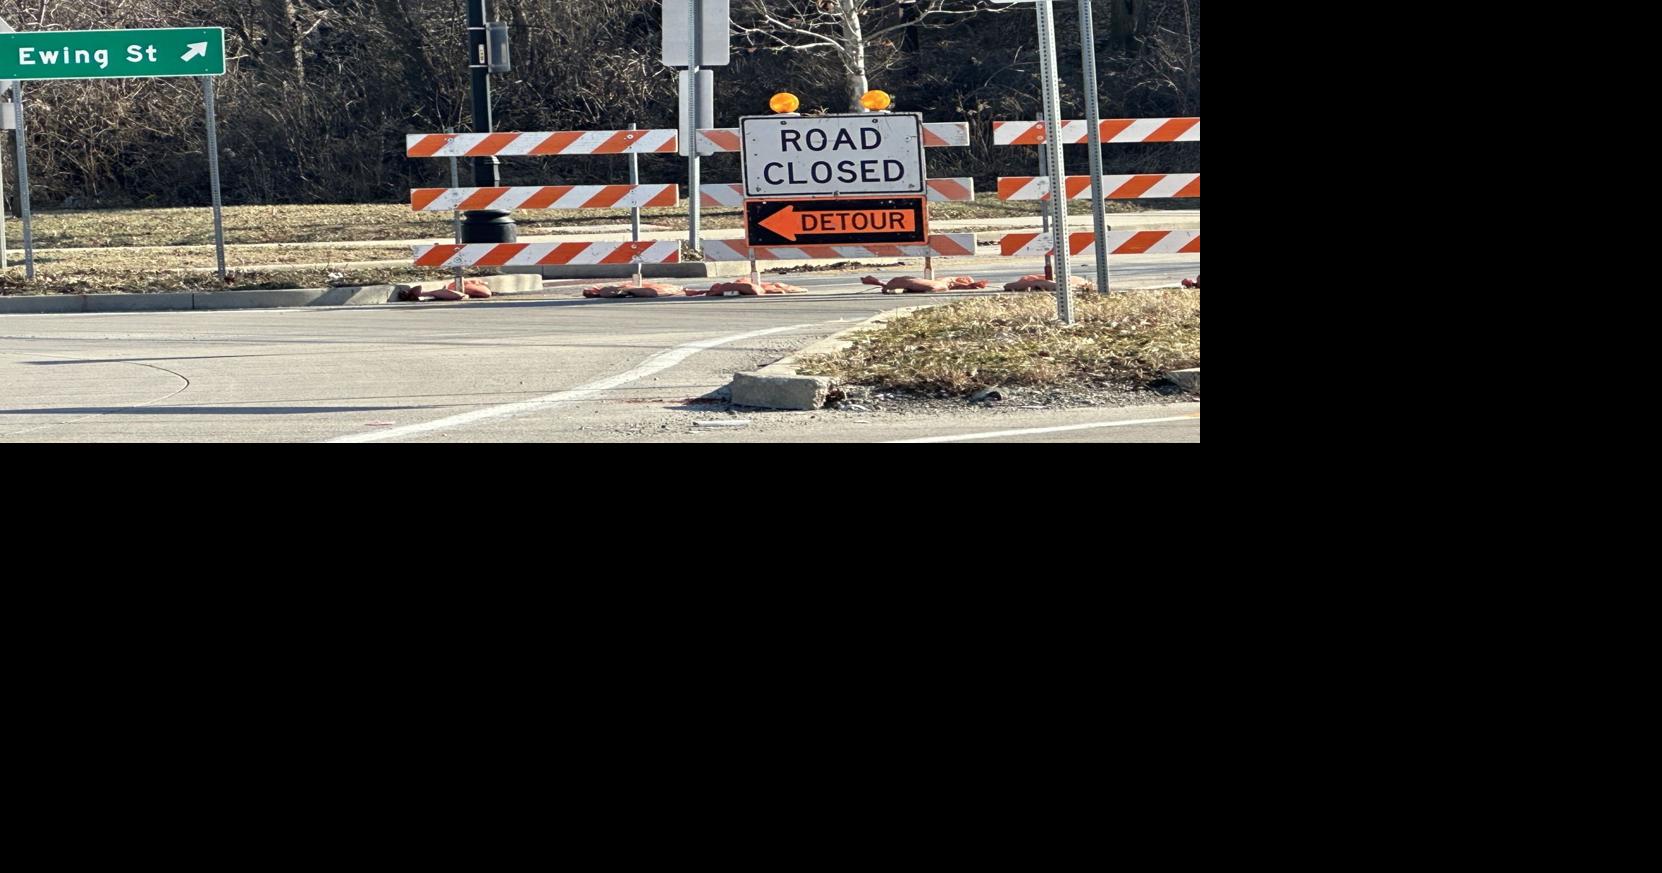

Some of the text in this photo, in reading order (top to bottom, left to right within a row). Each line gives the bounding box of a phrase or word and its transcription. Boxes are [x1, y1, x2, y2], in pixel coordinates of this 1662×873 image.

[19, 45, 157, 69] Ewing St
[780, 127, 882, 152] ROAD
[763, 159, 905, 185] CLOSED
[801, 212, 905, 231] DETOUR
